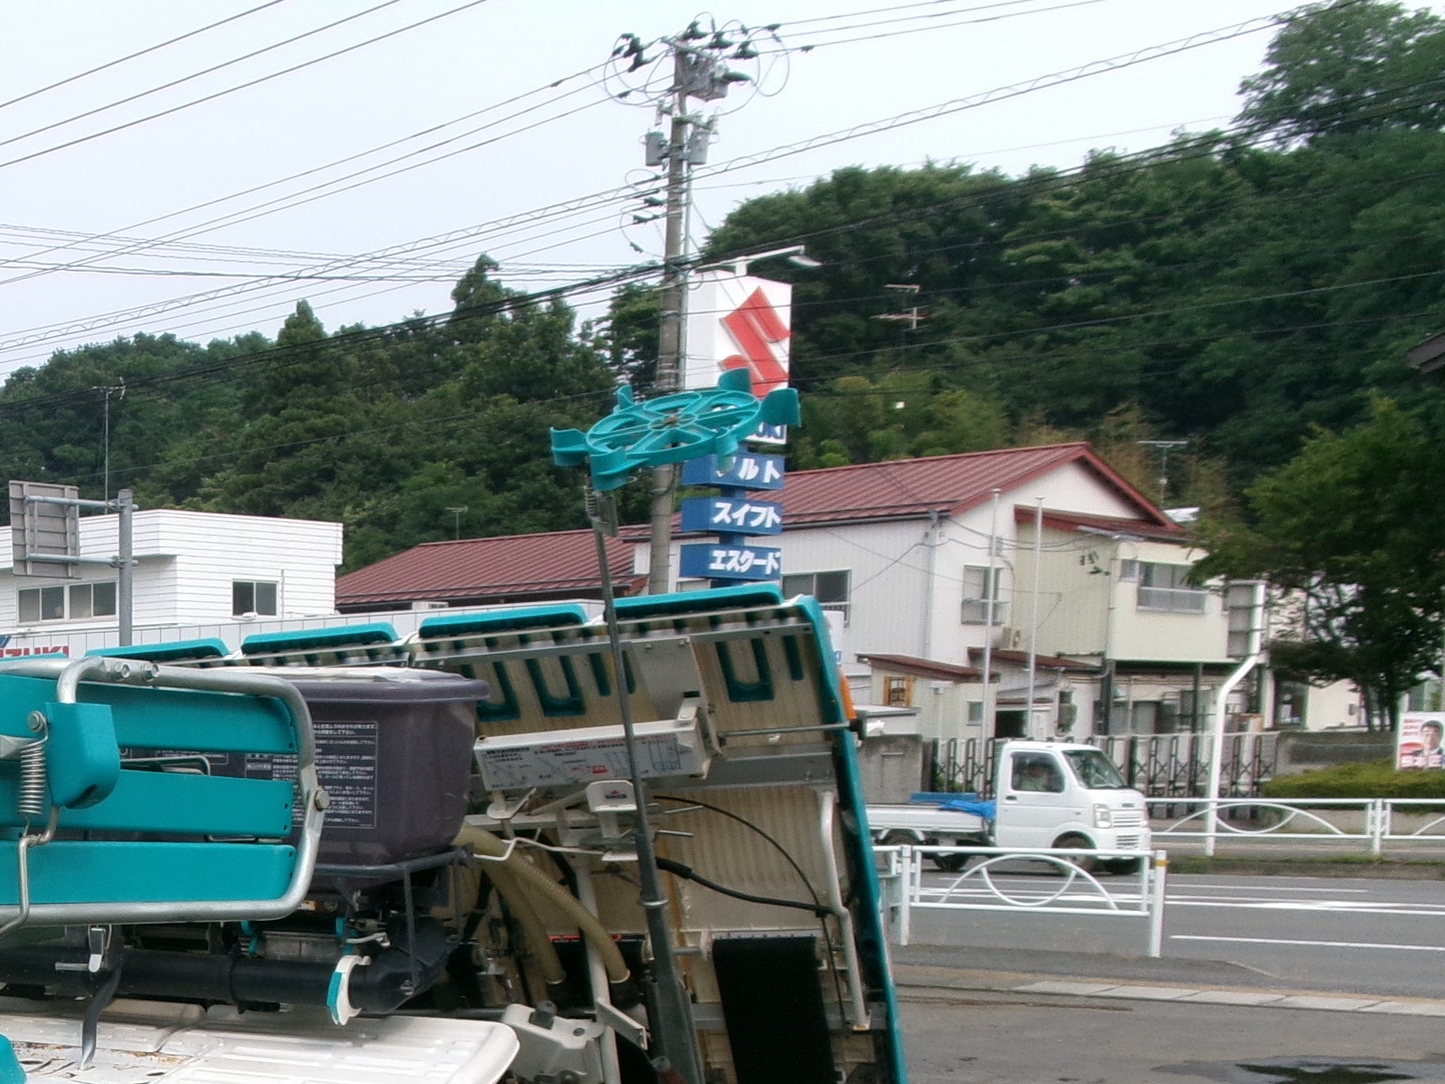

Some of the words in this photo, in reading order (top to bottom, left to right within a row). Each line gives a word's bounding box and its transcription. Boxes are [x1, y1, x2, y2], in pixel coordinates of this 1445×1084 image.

[716, 456, 781, 484] ルト
[712, 501, 782, 529] スイフト
[709, 549, 782, 575] エスクード
